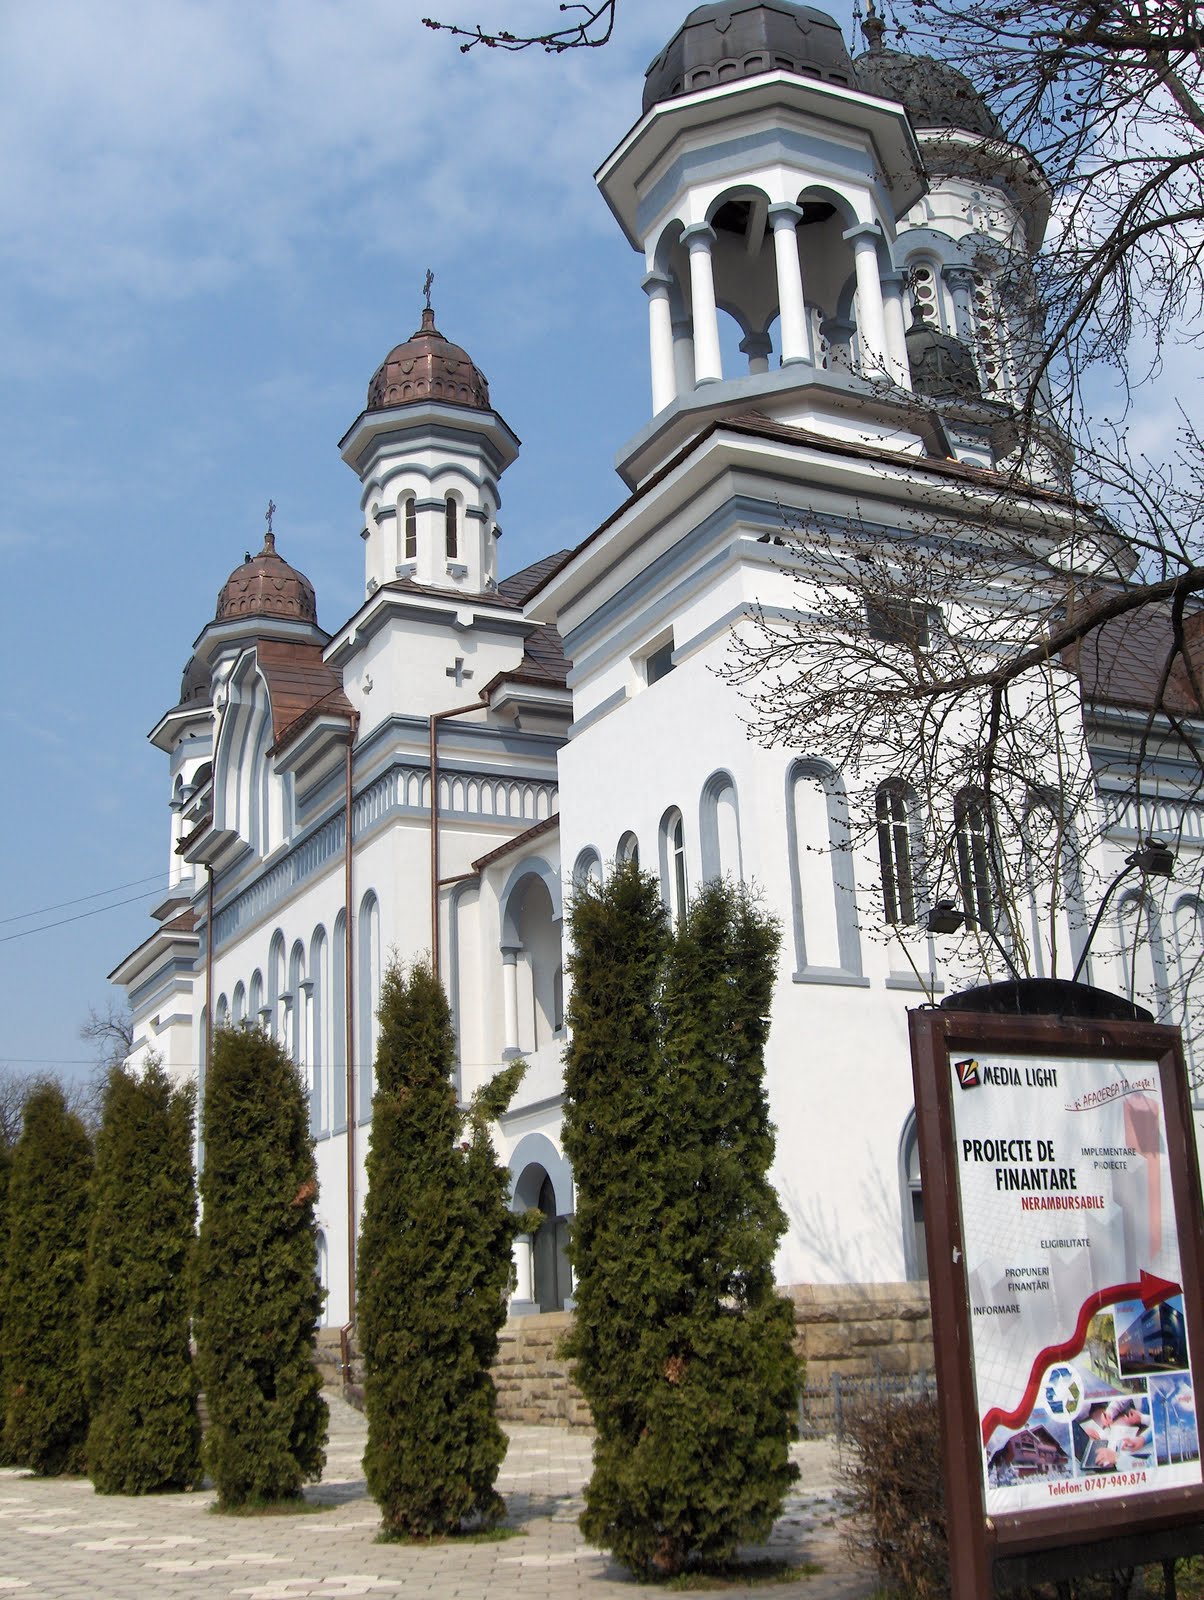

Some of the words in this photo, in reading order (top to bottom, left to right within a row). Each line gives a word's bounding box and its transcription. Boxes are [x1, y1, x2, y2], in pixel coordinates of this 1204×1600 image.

[983, 1066, 1021, 1087] MEDIA
[1025, 1068, 1058, 1088] LIGHT
[1083, 1083, 1120, 1107] AFACEREA
[1121, 1079, 1130, 1091] TA
[962, 1139, 1032, 1162] PROIECTE
[1037, 1140, 1055, 1162] DE
[1081, 1147, 1137, 1157] IMPLEMENTARE
[1093, 1161, 1127, 1170] PROIECTE
[995, 1168, 1077, 1191] FINANTARE
[1021, 1195, 1105, 1211] NERAMBURSABILE
[1040, 1238, 1091, 1249] ELIGIBILITATE
[1005, 1266, 1049, 1278] PROPUNERI
[973, 1303, 1021, 1316] INFORMARE
[1048, 1481, 1083, 1497] Telefon:
[1084, 1471, 1147, 1492] 0747-949.874
